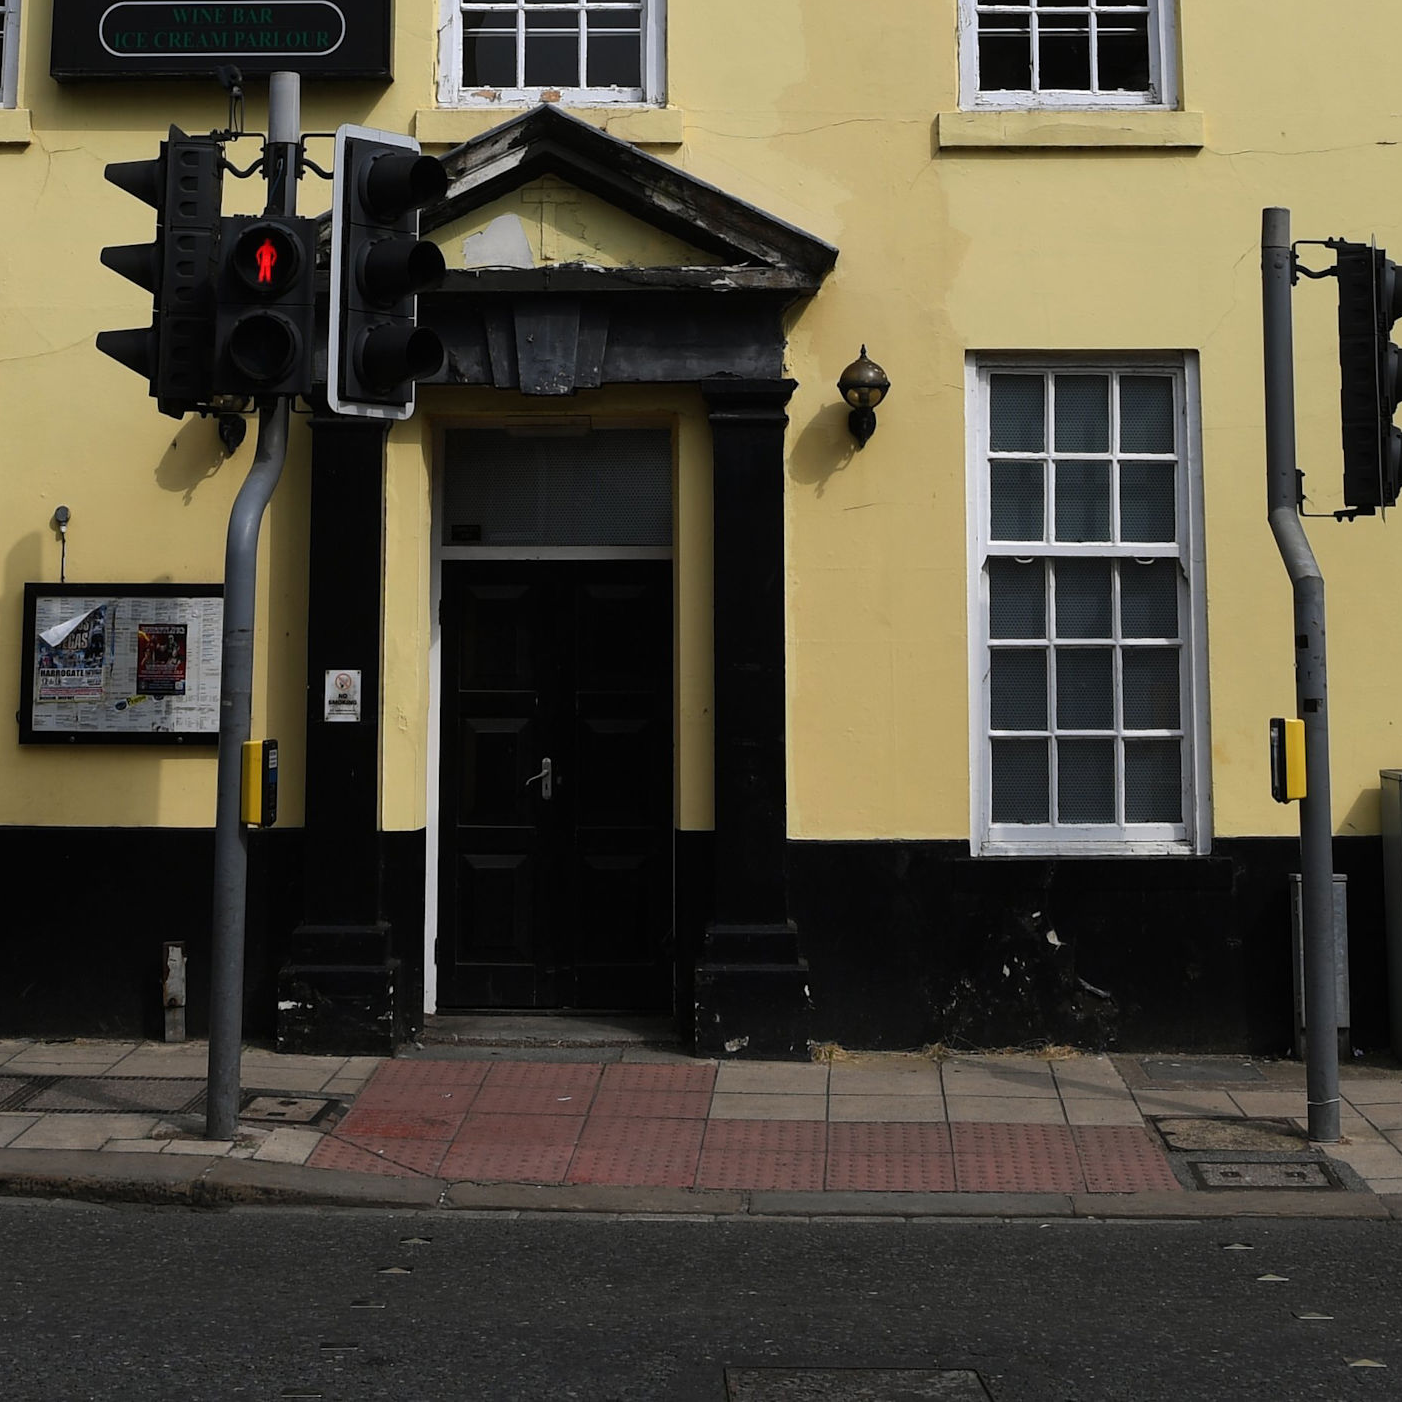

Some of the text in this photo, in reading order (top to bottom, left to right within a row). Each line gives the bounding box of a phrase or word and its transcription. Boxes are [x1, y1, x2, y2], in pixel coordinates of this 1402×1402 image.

[171, 7, 274, 25] WINE BAR
[112, 29, 331, 49] ICE CREAM PARLOUR
